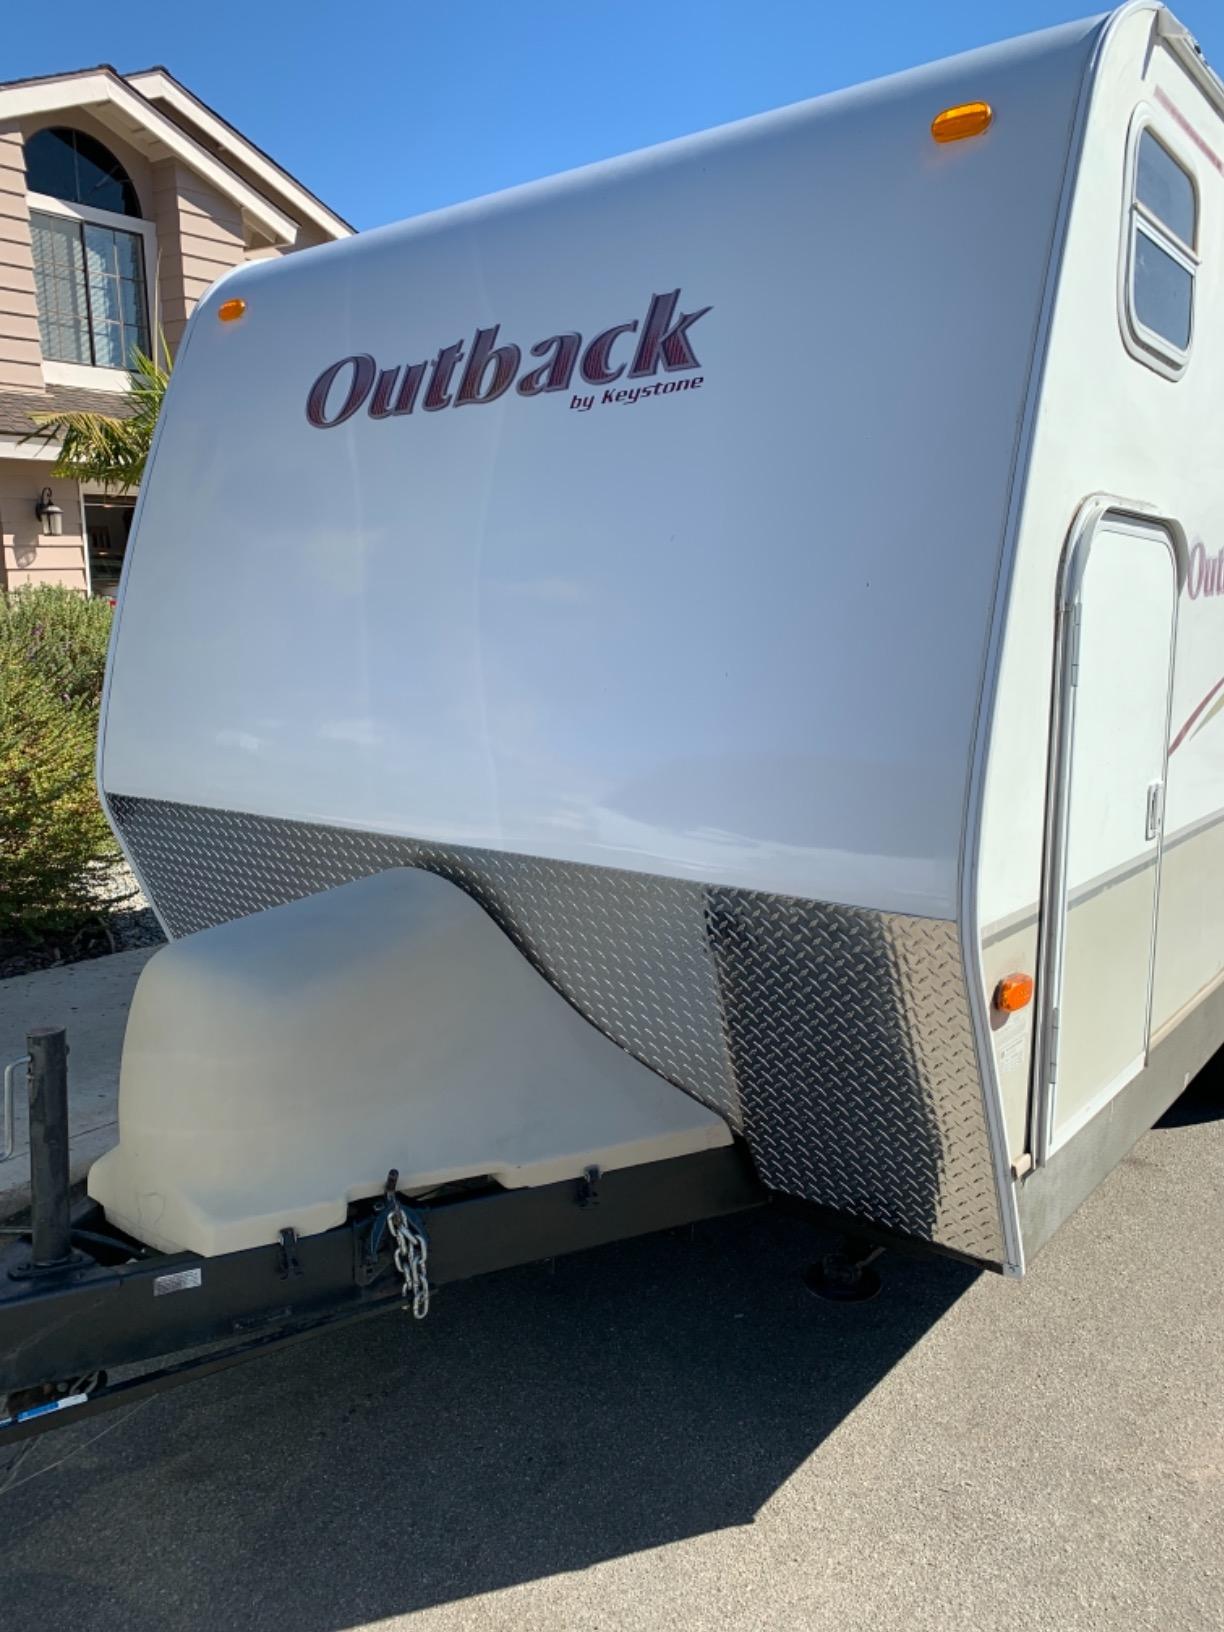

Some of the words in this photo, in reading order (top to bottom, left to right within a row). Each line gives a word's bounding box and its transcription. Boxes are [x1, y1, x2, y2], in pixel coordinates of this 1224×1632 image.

[306, 288, 714, 429] Outback
[569, 394, 595, 412] by
[601, 376, 704, 406] Keystone
